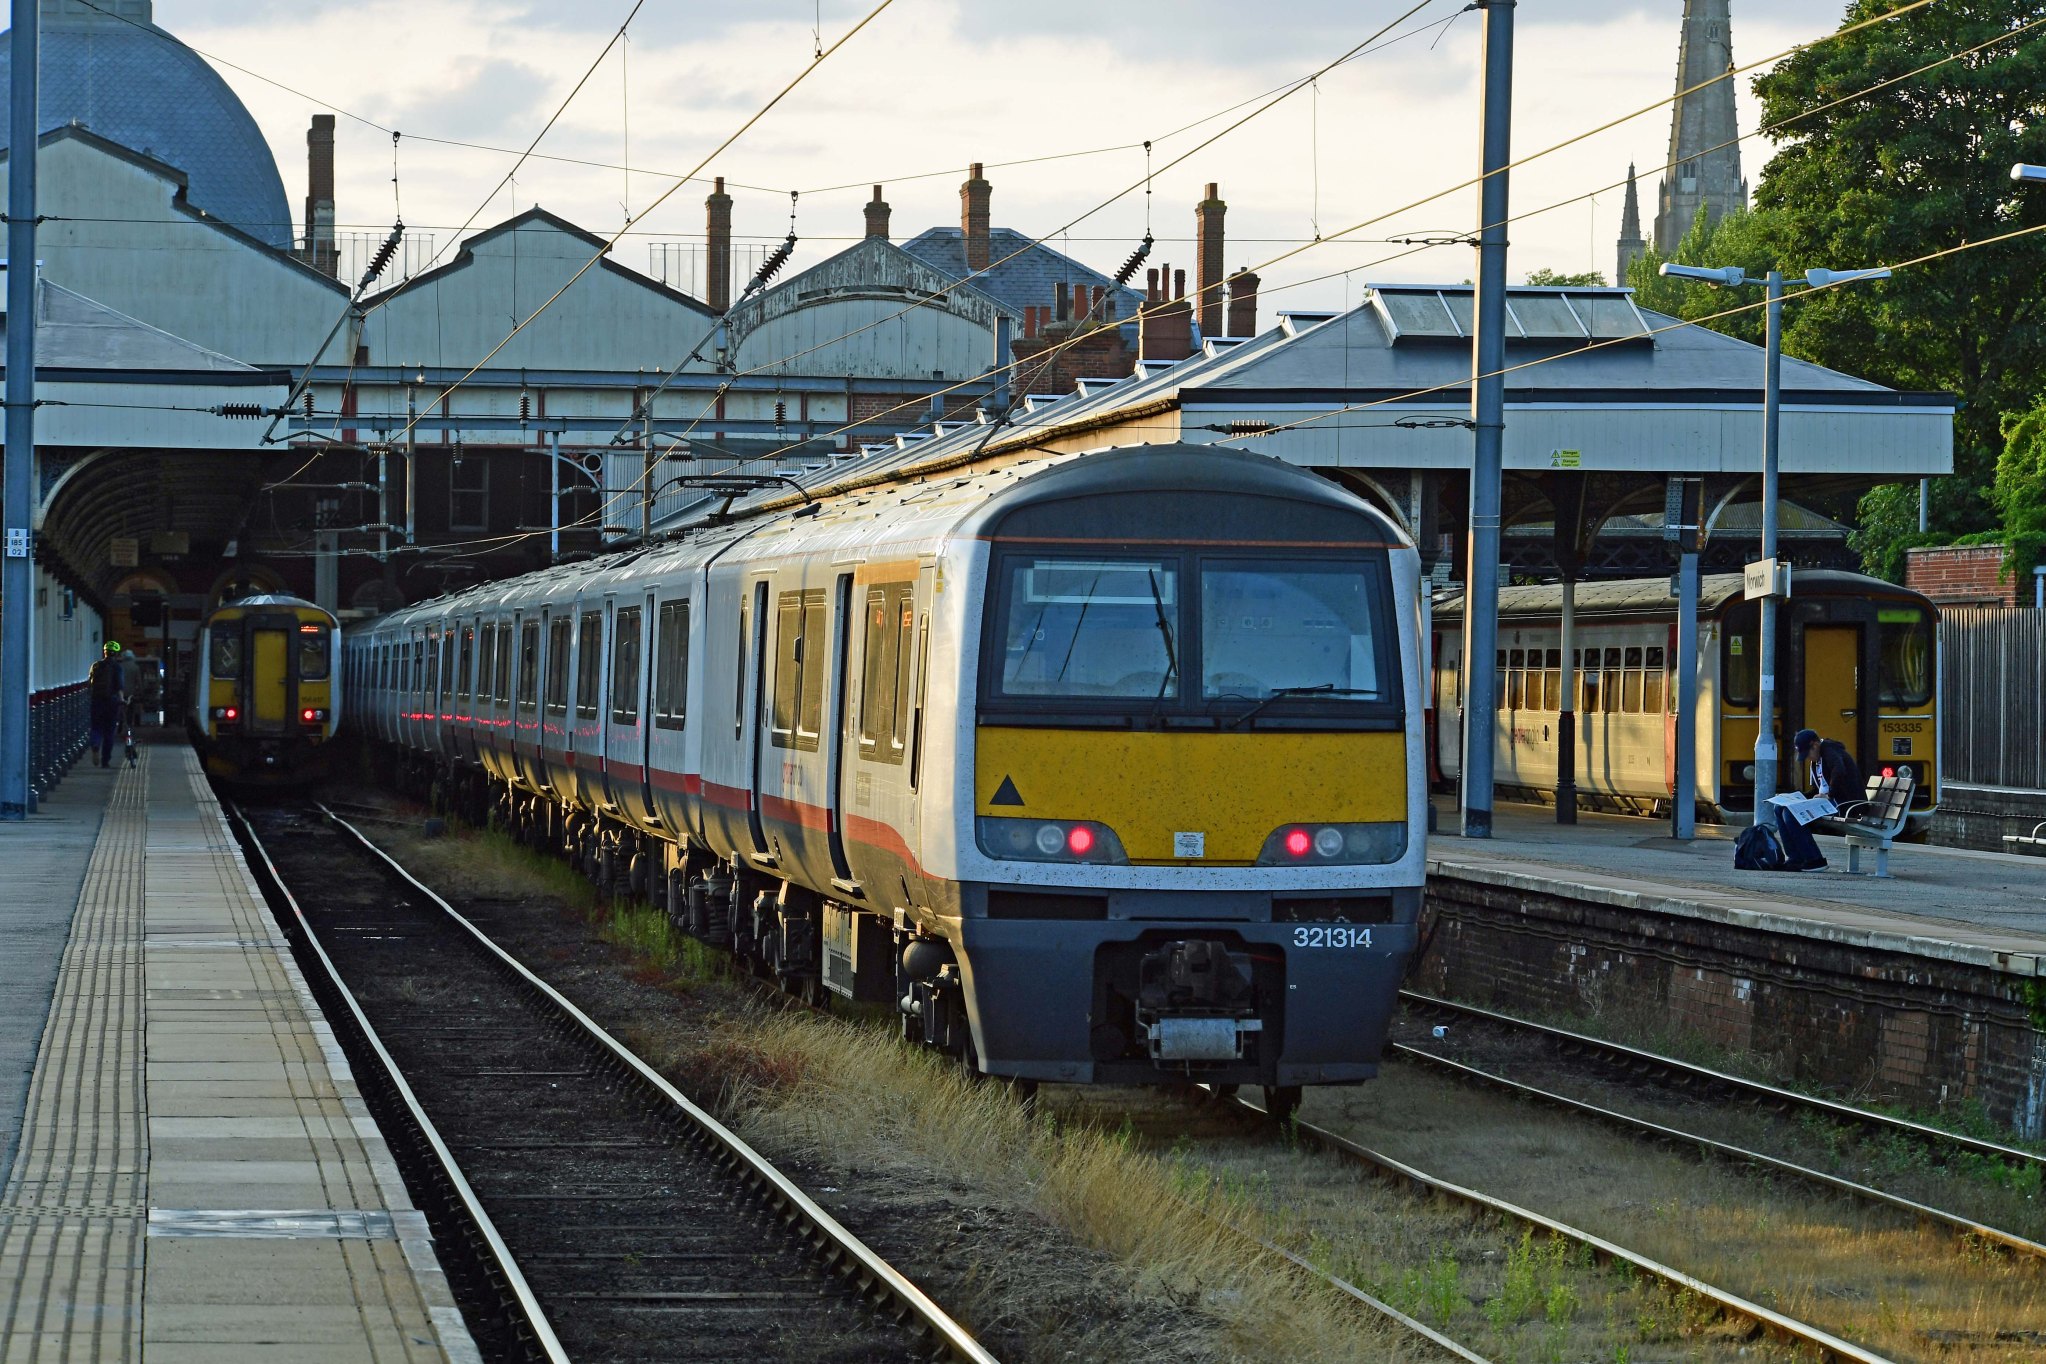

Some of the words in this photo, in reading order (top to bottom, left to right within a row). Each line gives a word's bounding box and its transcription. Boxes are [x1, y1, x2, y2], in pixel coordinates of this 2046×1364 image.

[1746, 569, 1765, 590] Norwich
[1882, 722, 1922, 733] 153335
[1293, 927, 1373, 948] 321314
